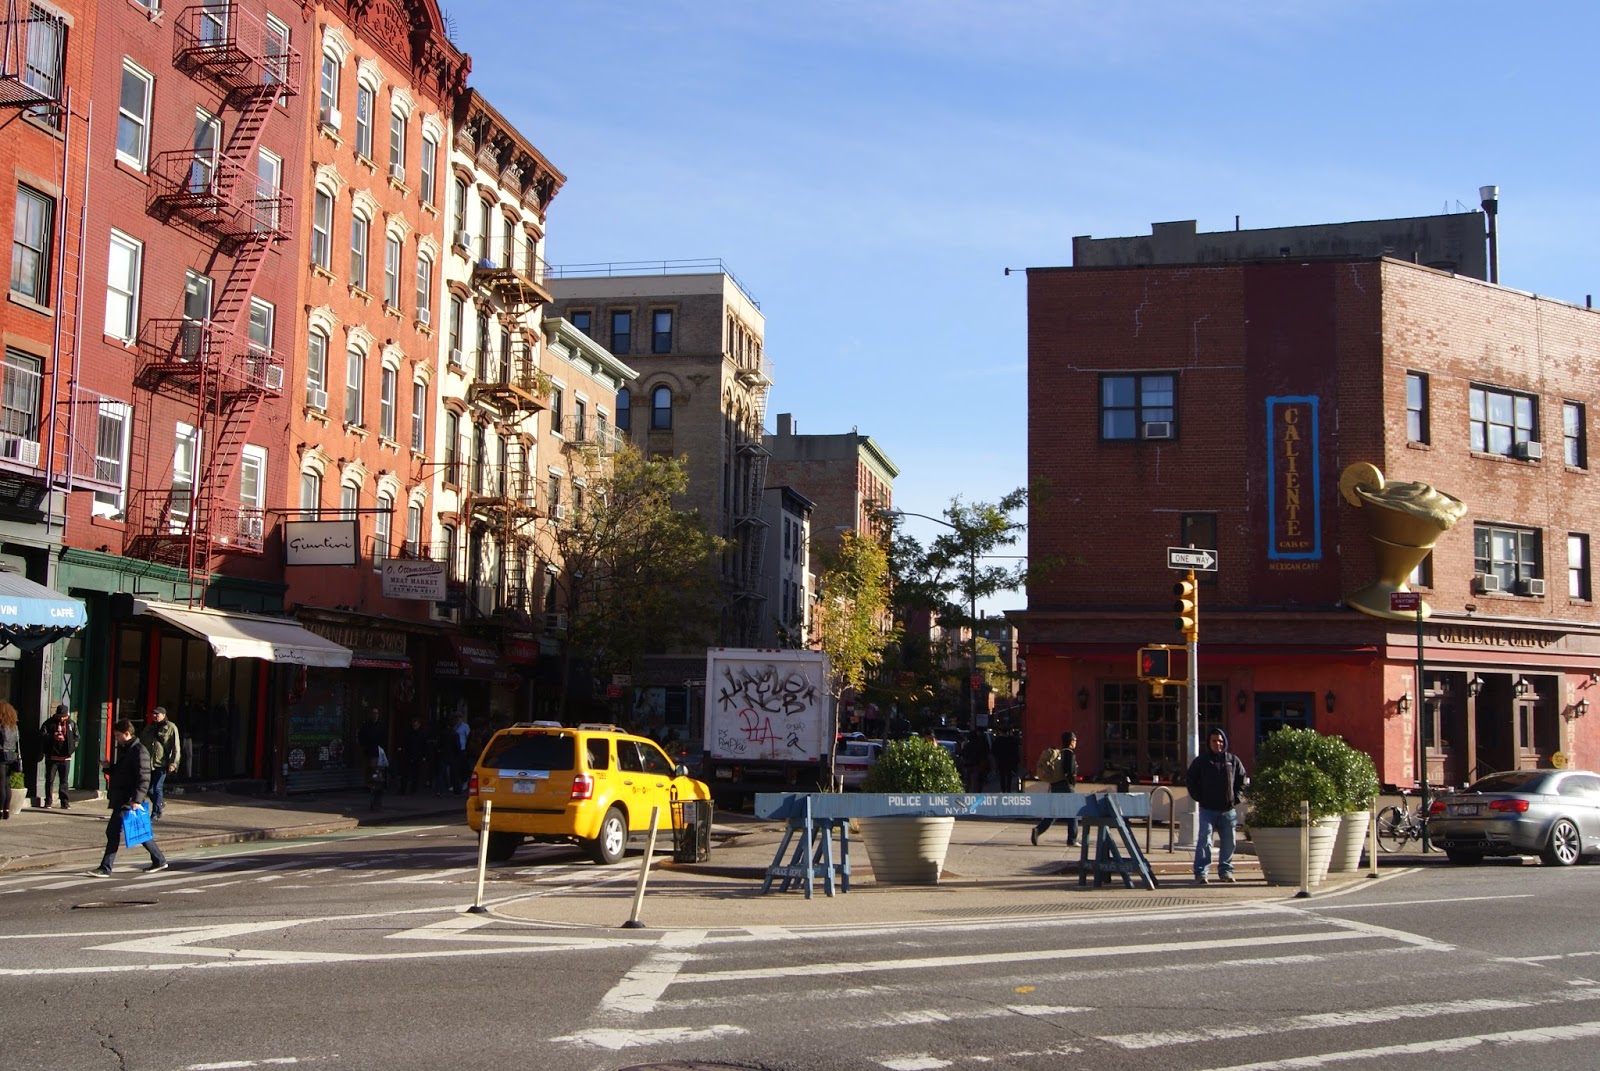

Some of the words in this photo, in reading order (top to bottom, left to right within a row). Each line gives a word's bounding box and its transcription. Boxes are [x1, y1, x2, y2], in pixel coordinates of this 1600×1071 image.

[1284, 408, 1301, 536] CALIENTE
[289, 537, 353, 553] Giuntini
[1175, 554, 1190, 563] ONE
[1195, 556, 1210, 564] WAY
[1269, 562, 1301, 570] MEXICAN
[410, 578, 438, 586] MARKET
[0, 604, 18, 616] VINI
[1439, 626, 1507, 647] CALIENTE
[1508, 630, 1537, 648] CAB
[888, 795, 921, 806] POLICE
[929, 796, 950, 806] LINE
[1001, 796, 1032, 806] CROSS
[771, 867, 788, 876] POLICE
